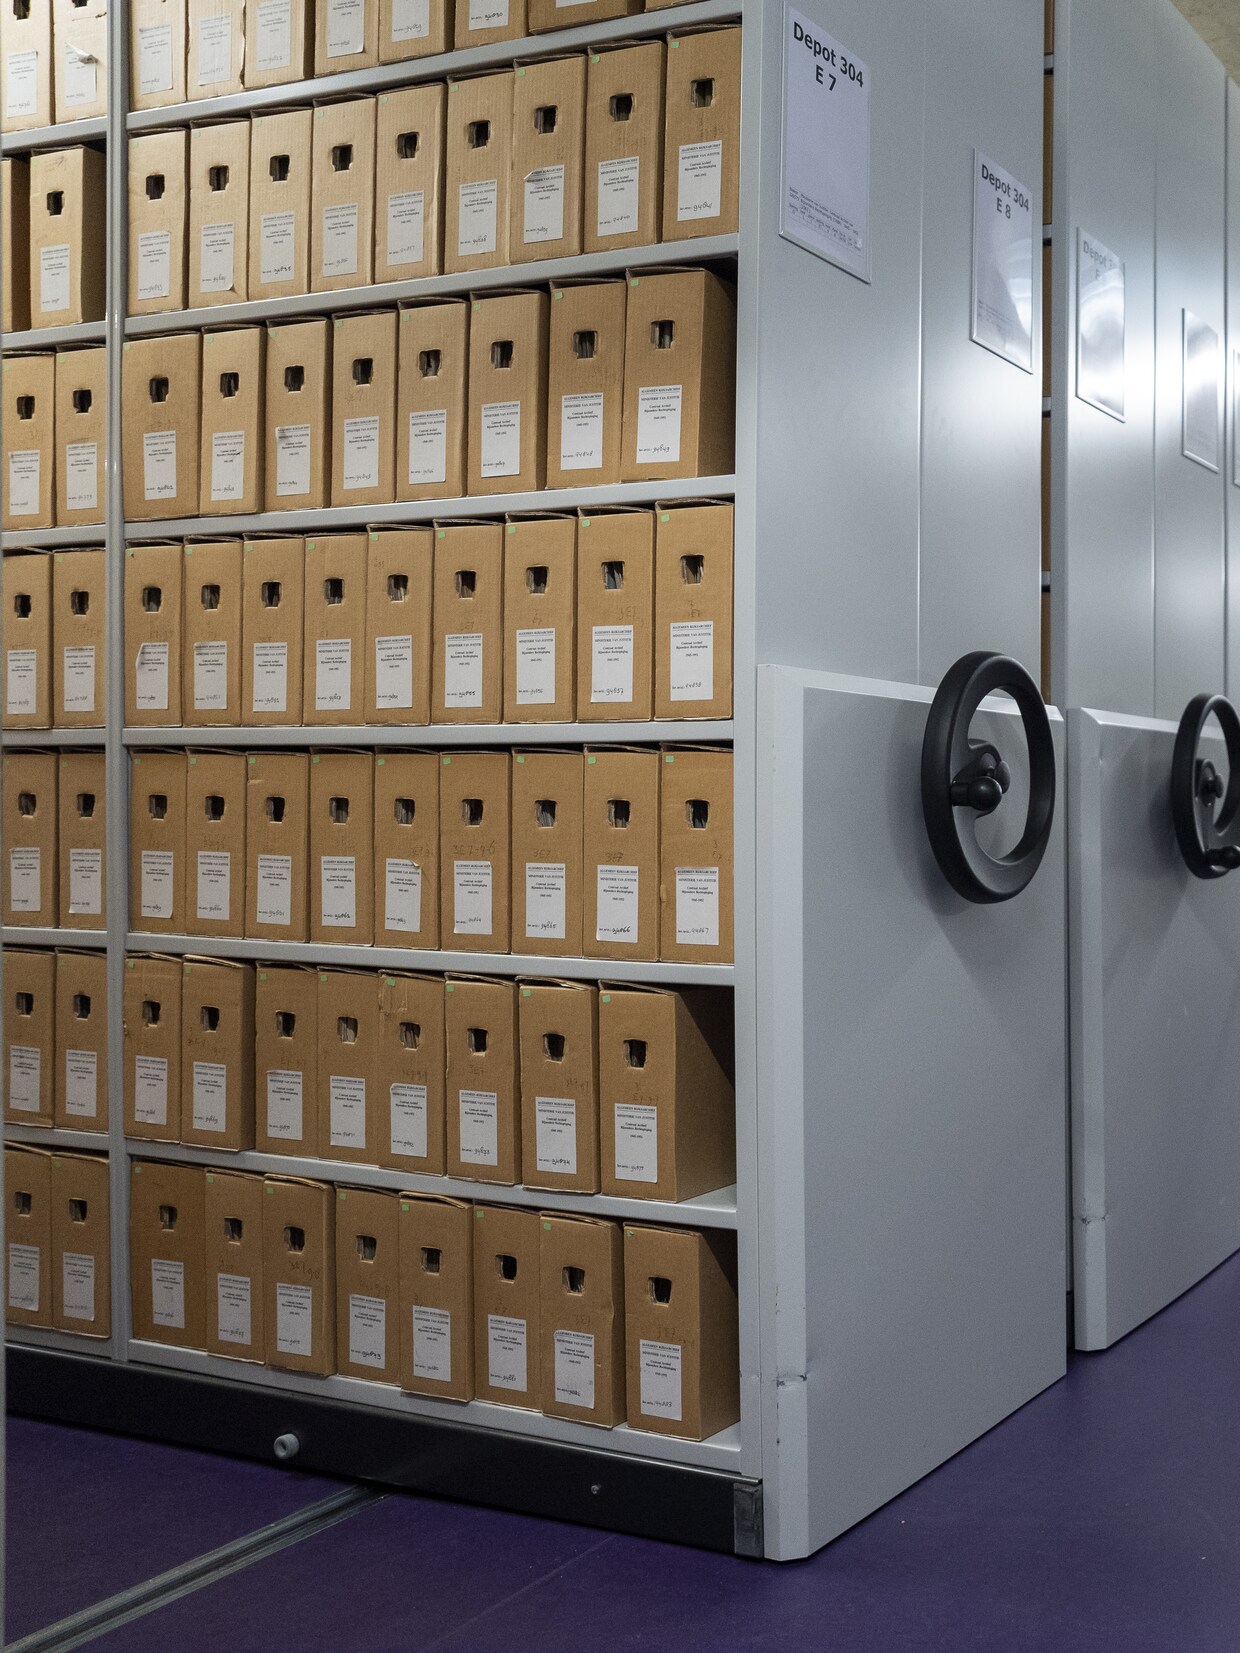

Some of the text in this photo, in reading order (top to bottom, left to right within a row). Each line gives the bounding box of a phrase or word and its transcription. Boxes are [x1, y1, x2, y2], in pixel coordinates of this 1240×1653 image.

[793, 21, 864, 88] Depot 304
[815, 64, 837, 92] E 7
[981, 163, 1029, 212] Depot 304
[997, 199, 1011, 220] E 8
[1083, 240, 1107, 267] Depot
